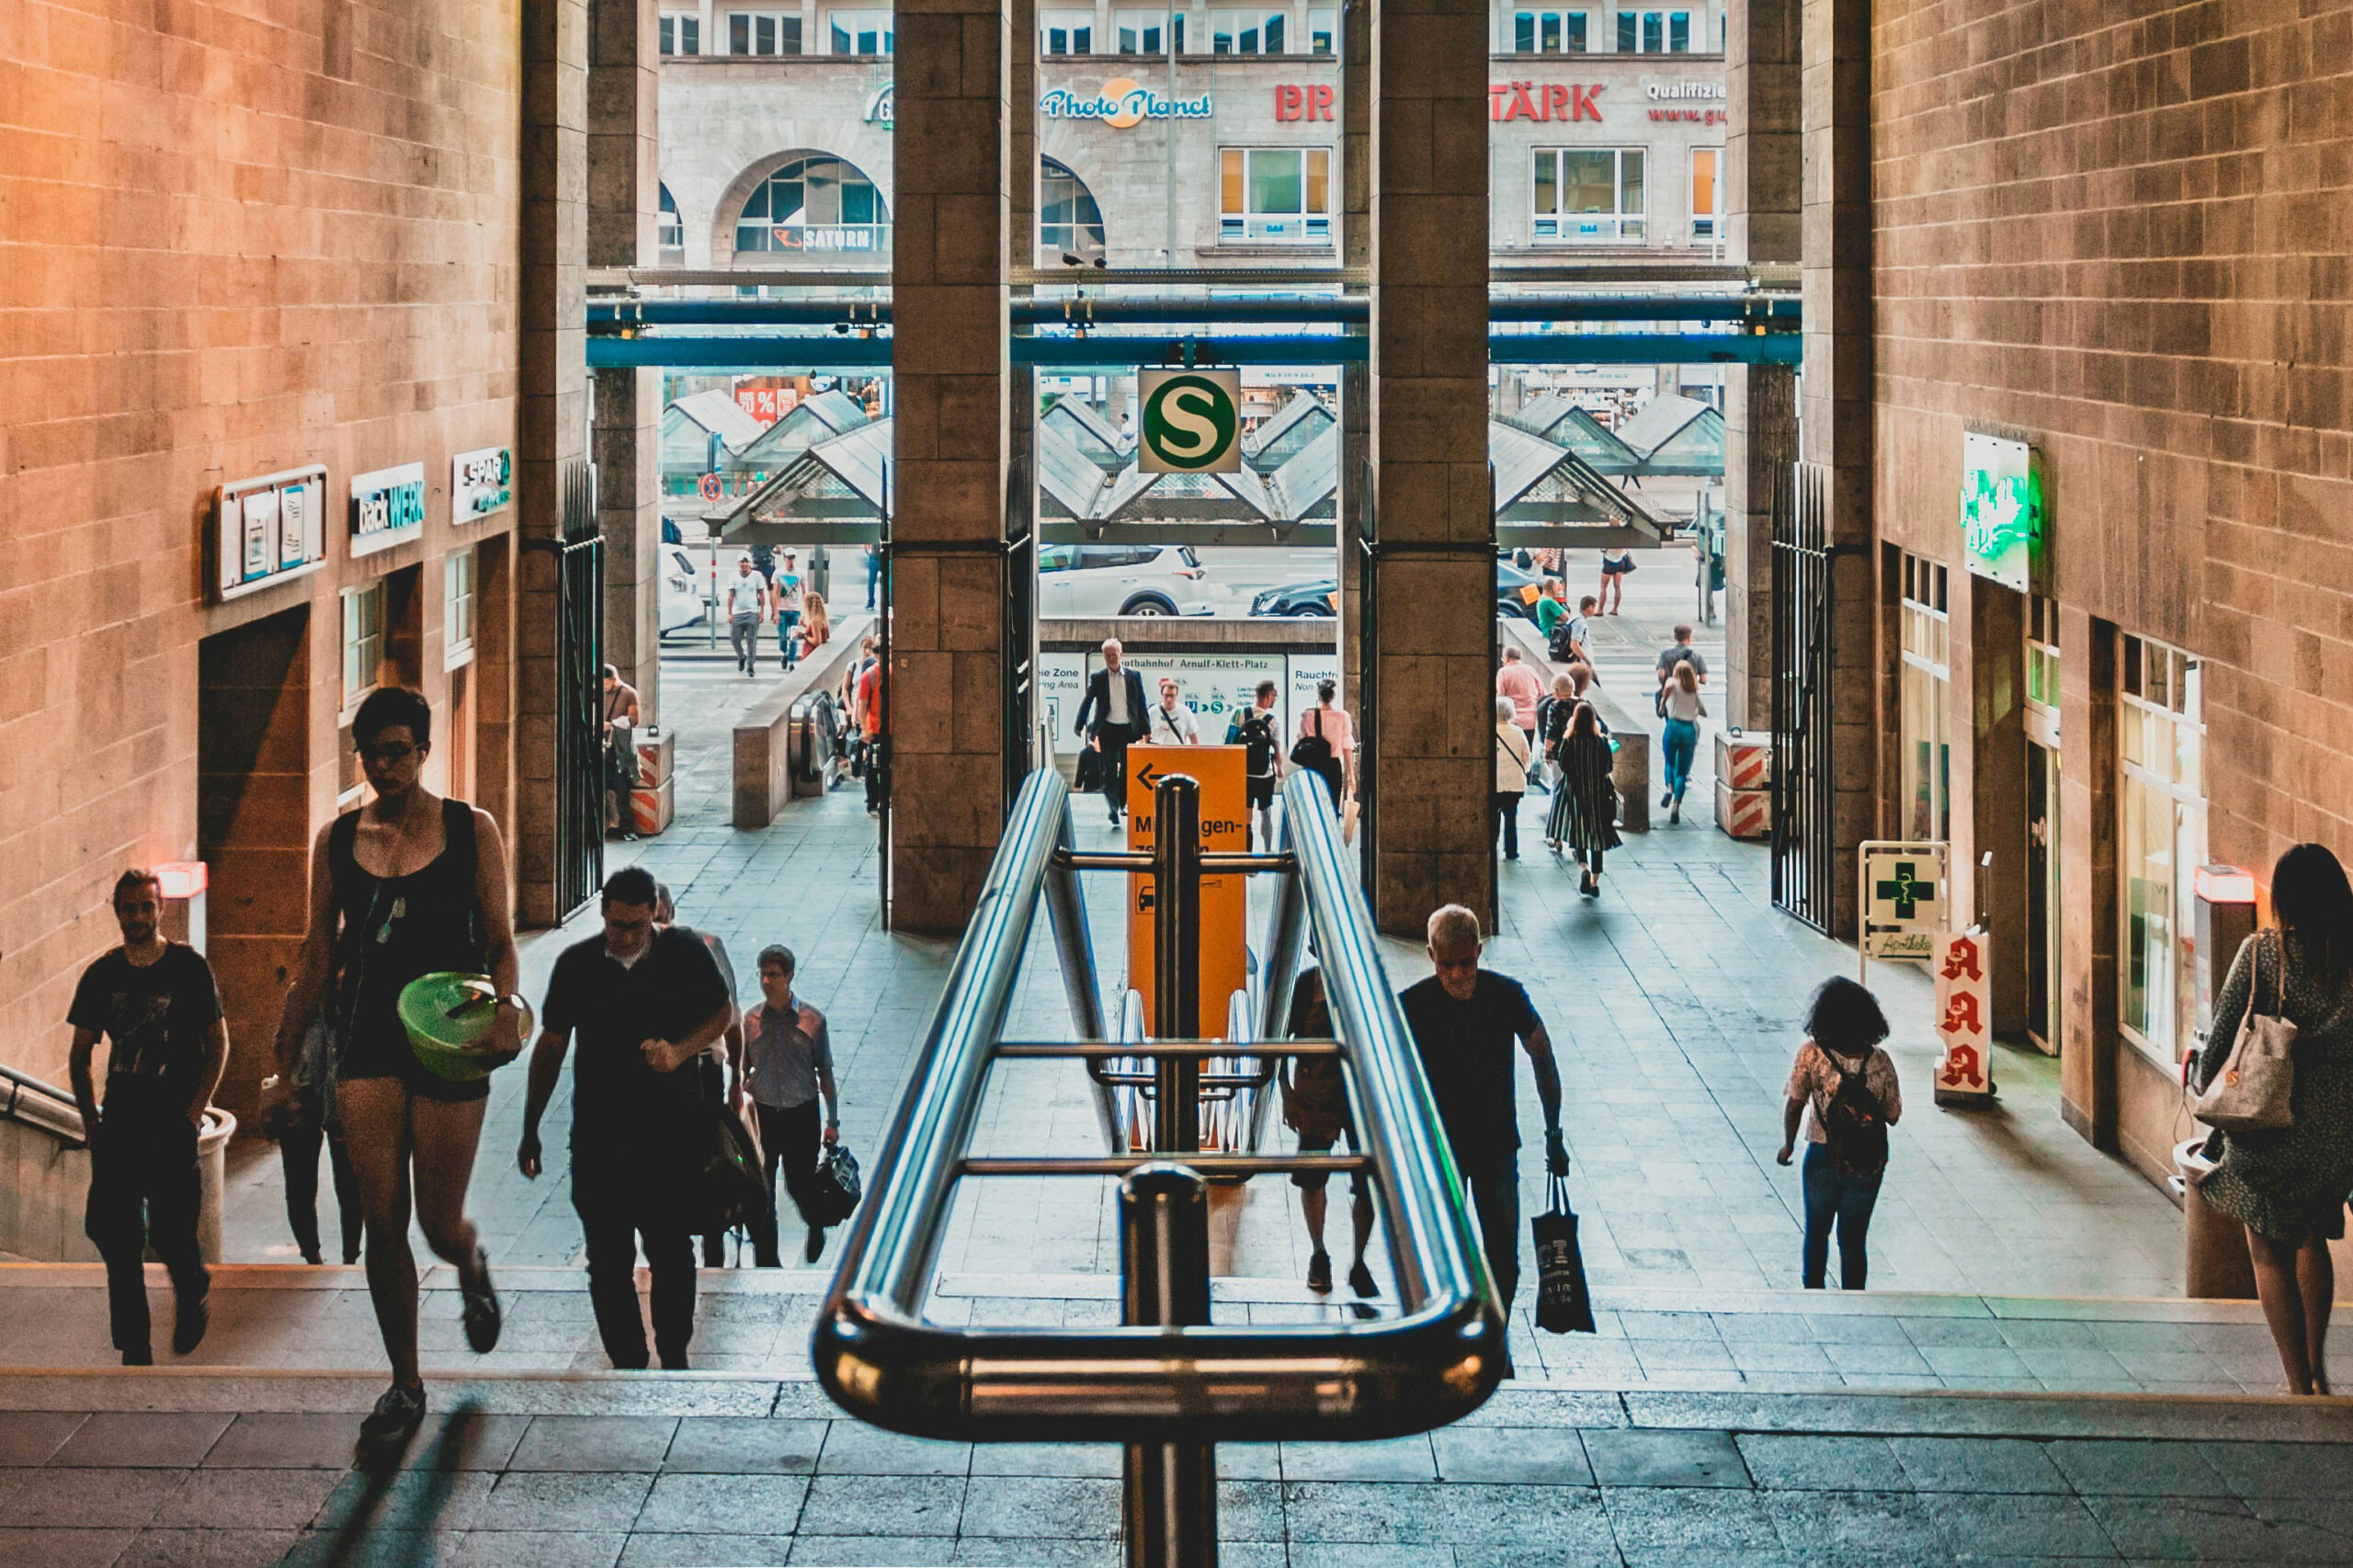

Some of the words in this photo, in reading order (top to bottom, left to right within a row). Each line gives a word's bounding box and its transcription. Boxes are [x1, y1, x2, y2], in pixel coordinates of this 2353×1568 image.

[1040, 89, 1119, 116] Photo
[1122, 89, 1211, 116] Planet
[805, 230, 869, 247] SATURN
[1160, 385, 1218, 458] S
[469, 456, 502, 487] SPAR
[1180, 658, 1268, 669] Arnulf-Klett-Platz
[1052, 668, 1079, 677] Zone
[1058, 681, 1079, 689] Area
